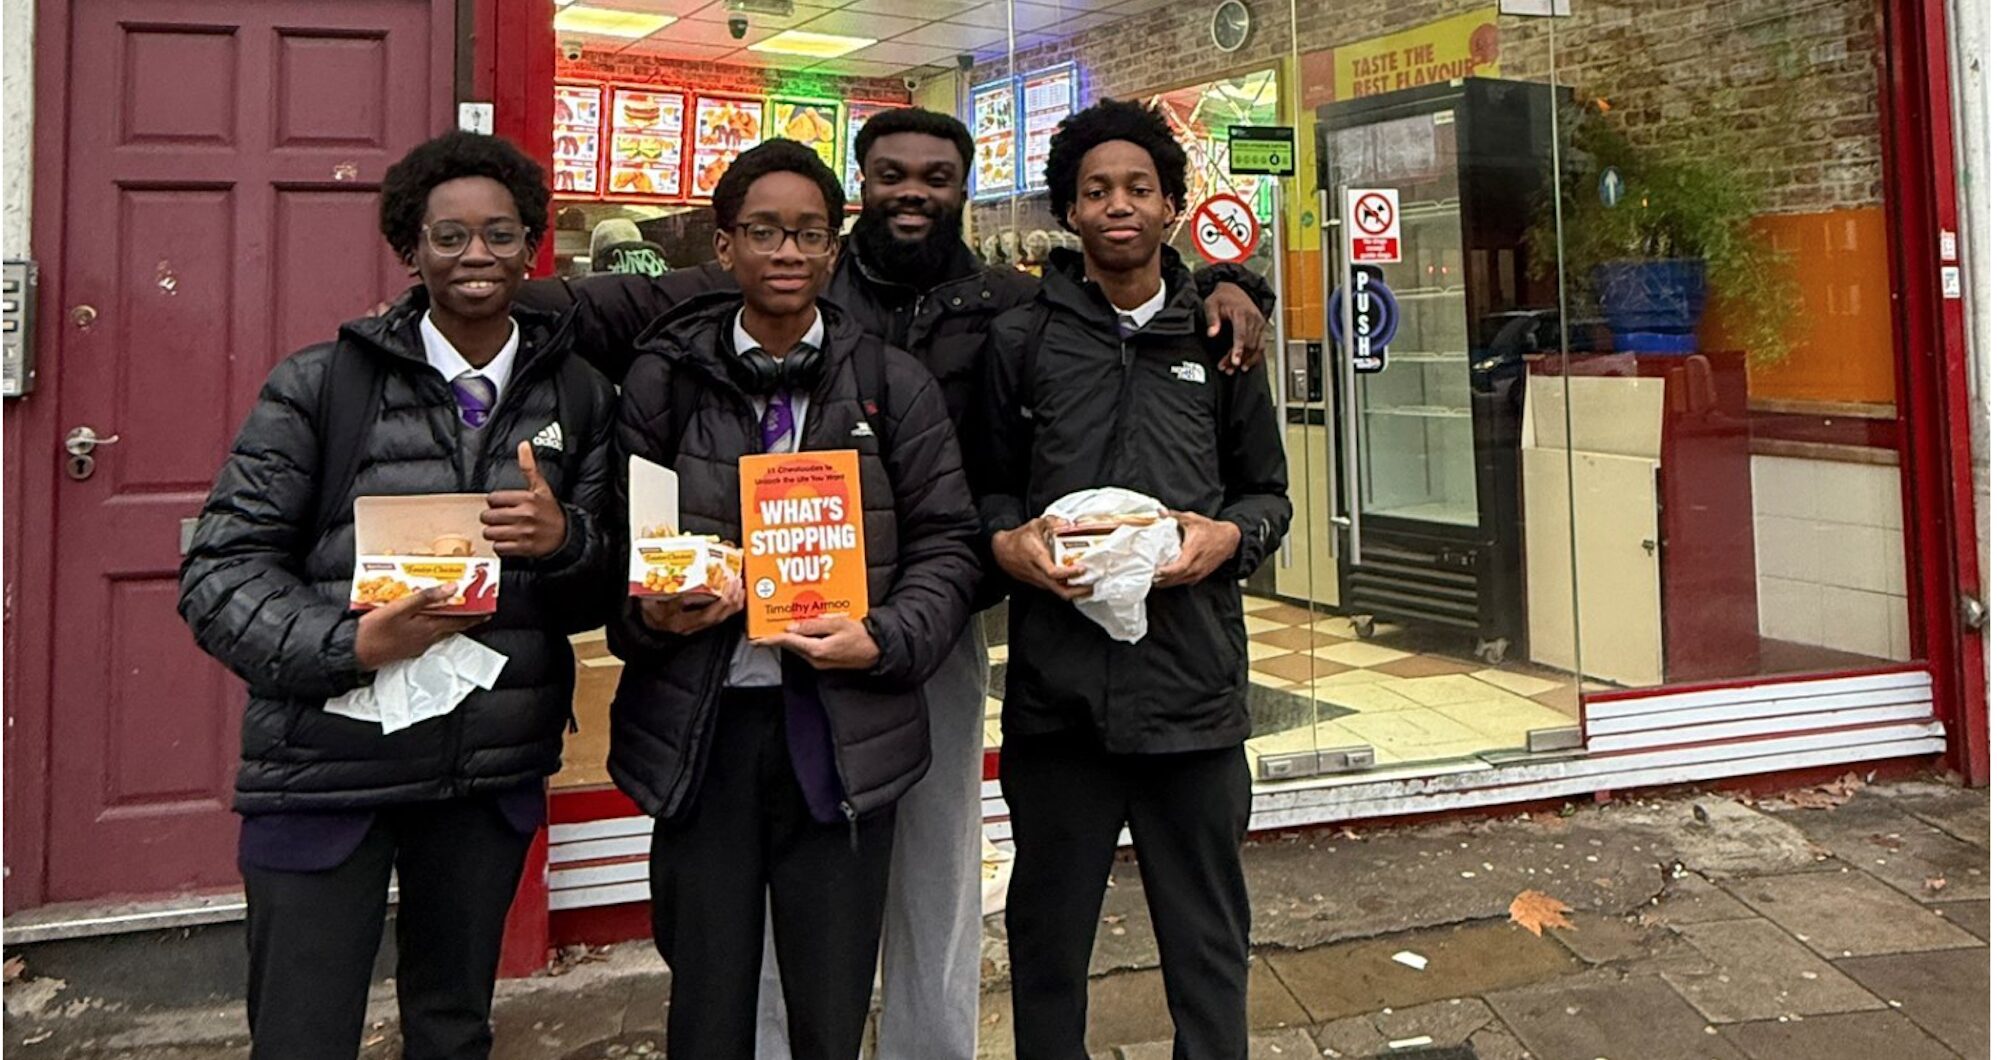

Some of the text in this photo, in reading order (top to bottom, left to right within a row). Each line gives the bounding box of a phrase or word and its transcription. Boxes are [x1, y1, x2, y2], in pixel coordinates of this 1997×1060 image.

[1352, 43, 1435, 78] TASTE THE
[1353, 56, 1476, 97] BEST FLAVOUR
[1357, 271, 1370, 356] PUSH
[760, 495, 844, 526] WHAT'S
[750, 523, 856, 556] STOPPING
[776, 554, 834, 584] YOU?
[765, 599, 850, 615] Timothy Armoo
